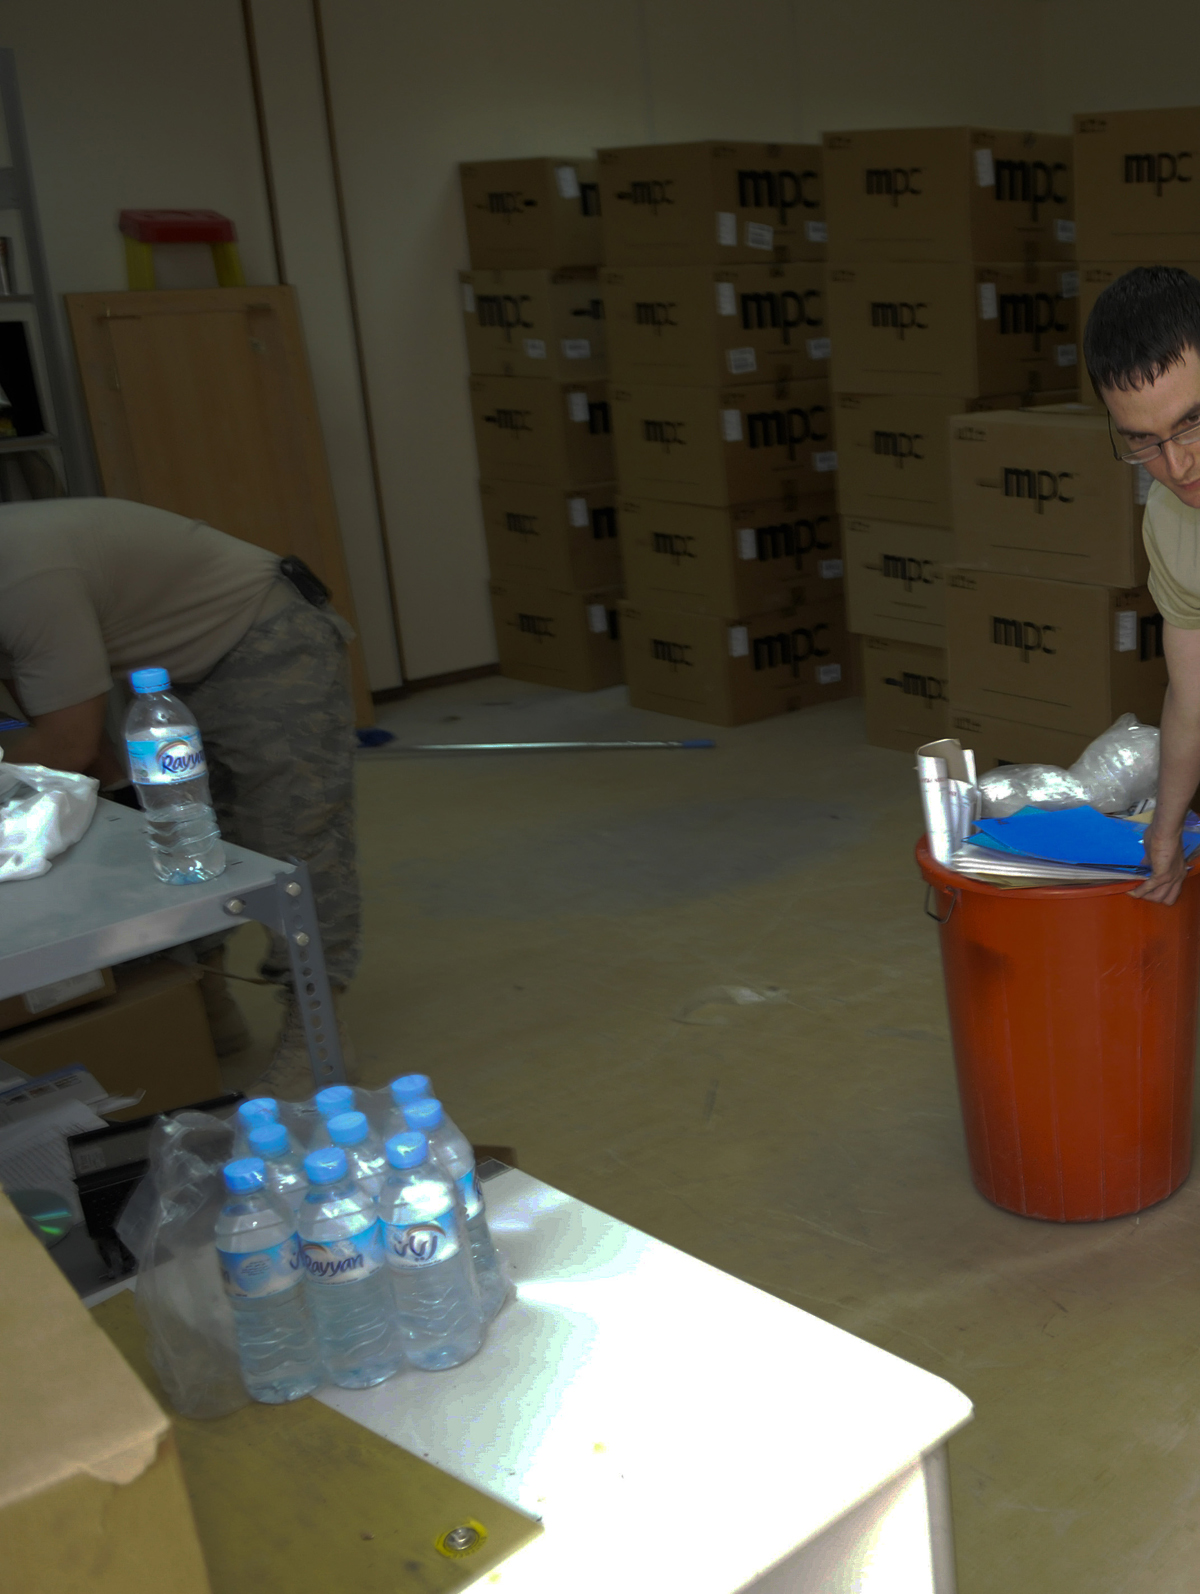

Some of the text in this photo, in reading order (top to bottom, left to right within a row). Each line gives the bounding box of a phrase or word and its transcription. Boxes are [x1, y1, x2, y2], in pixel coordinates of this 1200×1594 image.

[865, 167, 923, 208] mpc
[995, 159, 1067, 222] mpc
[1124, 151, 1193, 197] mpc
[631, 179, 674, 216] mpc
[737, 170, 820, 225] mpc
[476, 294, 534, 342] mpc
[634, 302, 678, 336] mpc
[740, 289, 822, 345] mpc
[871, 302, 928, 340] mpc
[643, 419, 686, 453] mpc
[746, 405, 828, 461] mpc
[873, 430, 925, 469] mpc
[1003, 466, 1076, 515] mpc
[652, 532, 696, 566] mpc
[756, 516, 832, 570] mpc
[882, 553, 934, 593] mpc
[651, 638, 693, 672] mpc
[752, 623, 830, 678] mpc
[992, 615, 1057, 664] mpc
[304, 1253, 364, 1277] Rayyan
